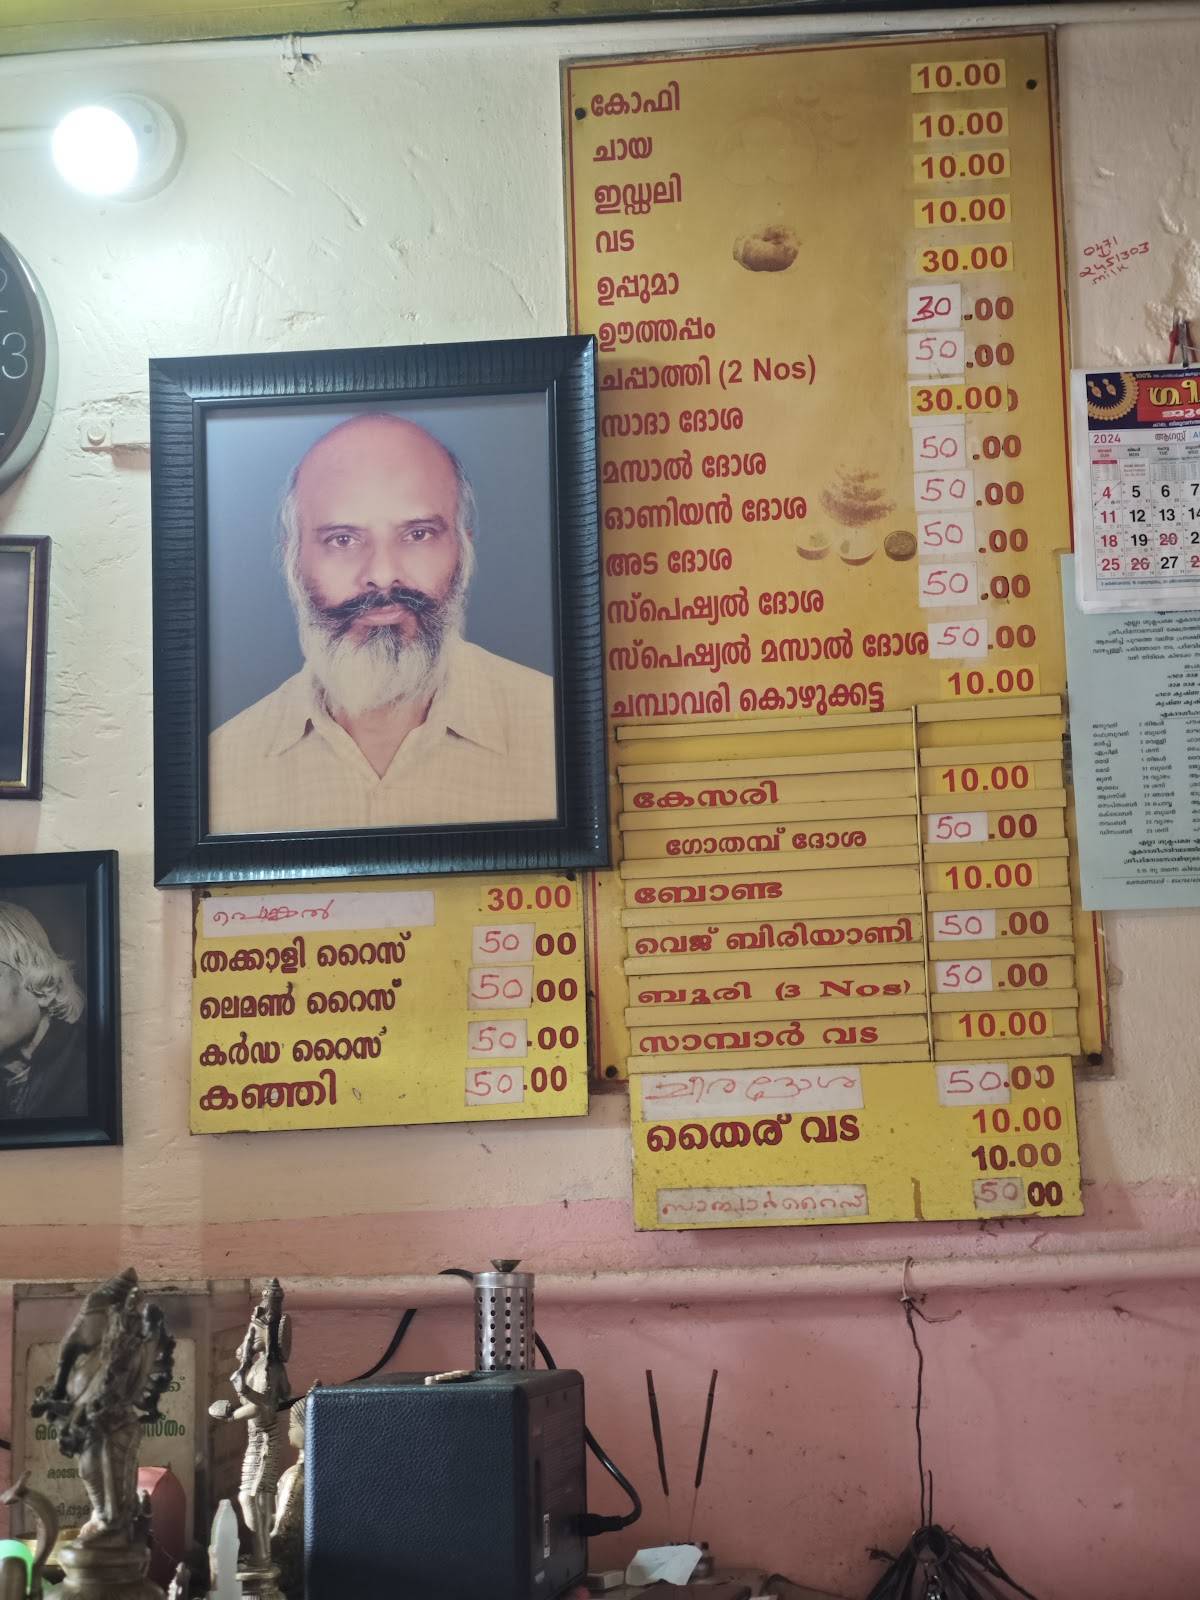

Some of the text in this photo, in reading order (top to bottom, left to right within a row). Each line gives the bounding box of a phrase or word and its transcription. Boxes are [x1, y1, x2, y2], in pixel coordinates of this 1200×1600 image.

[918, 64, 999, 88] 10.00
[591, 80, 680, 117] കോഫി
[920, 112, 1003, 138] 10.00
[592, 136, 653, 162] ചായ
[921, 153, 1005, 179] 10.00
[593, 172, 683, 214] ഇഡ്ഡലി
[921, 198, 1006, 224] 10.00
[595, 229, 637, 255] വട
[922, 245, 1008, 272] 30.00
[596, 272, 681, 307] ഉപ്പുമാ
[598, 317, 717, 352] ഊത്തപ്പം
[1, 331, 28, 380] 3
[599, 353, 816, 391] ചപ്പാത്തി (2 Nos)
[602, 407, 745, 435] സാദാ ദോശ
[1093, 434, 1121, 444] 2024
[603, 449, 768, 483] മസാൽ ദോശ
[1103, 486, 1111, 499] 4
[1132, 485, 1140, 498] 5
[1161, 484, 1170, 497] 6
[1190, 483, 1200, 496] 7
[604, 494, 809, 529] ഓണിയൻ ദോശ
[1100, 510, 1115, 523] 11
[1129, 509, 1146, 522] 12
[1159, 508, 1175, 521] 13
[1101, 534, 1118, 547] 18
[1130, 533, 1147, 546] 19
[1159, 532, 1178, 546] 20
[1190, 531, 1200, 545] 2
[606, 547, 734, 576] അട ദോശ
[1101, 558, 1120, 571] 25
[1130, 557, 1149, 571] 26
[1160, 556, 1178, 569] 27
[1190, 555, 1200, 568] 2
[756, 589, 825, 616] ദോശ
[761, 627, 853, 664] മസാൽ
[862, 631, 929, 657] ദോശ
[948, 667, 1035, 696] 10.00
[609, 681, 886, 720] ചമ്പാവരി കൊഴുക്കട്ട
[943, 763, 1029, 792] 10.00
[633, 778, 779, 810] കേസരി
[666, 827, 868, 856] ഗോതമ്പ് ദോശ
[946, 863, 1033, 890] 10.00
[488, 883, 573, 912] 30.00
[634, 880, 783, 905] ബോണ്ട
[635, 917, 913, 956] വെജ് ബിരിയാണി
[201, 932, 411, 973] തക്കാളി റൈസ്
[199, 978, 401, 1020] ലെമൺ റൈസ്
[820, 977, 911, 998] Nos)
[640, 1019, 879, 1055] സാമ്പാർ വട
[960, 1009, 1047, 1040] 10.00
[292, 1026, 388, 1062] റൈസ്
[201, 1069, 337, 1110] കഞ്ഞി
[647, 1114, 861, 1152] തൈര് വട
[973, 1106, 1061, 1135] 10.00
[972, 1143, 1060, 1171] 10.00
